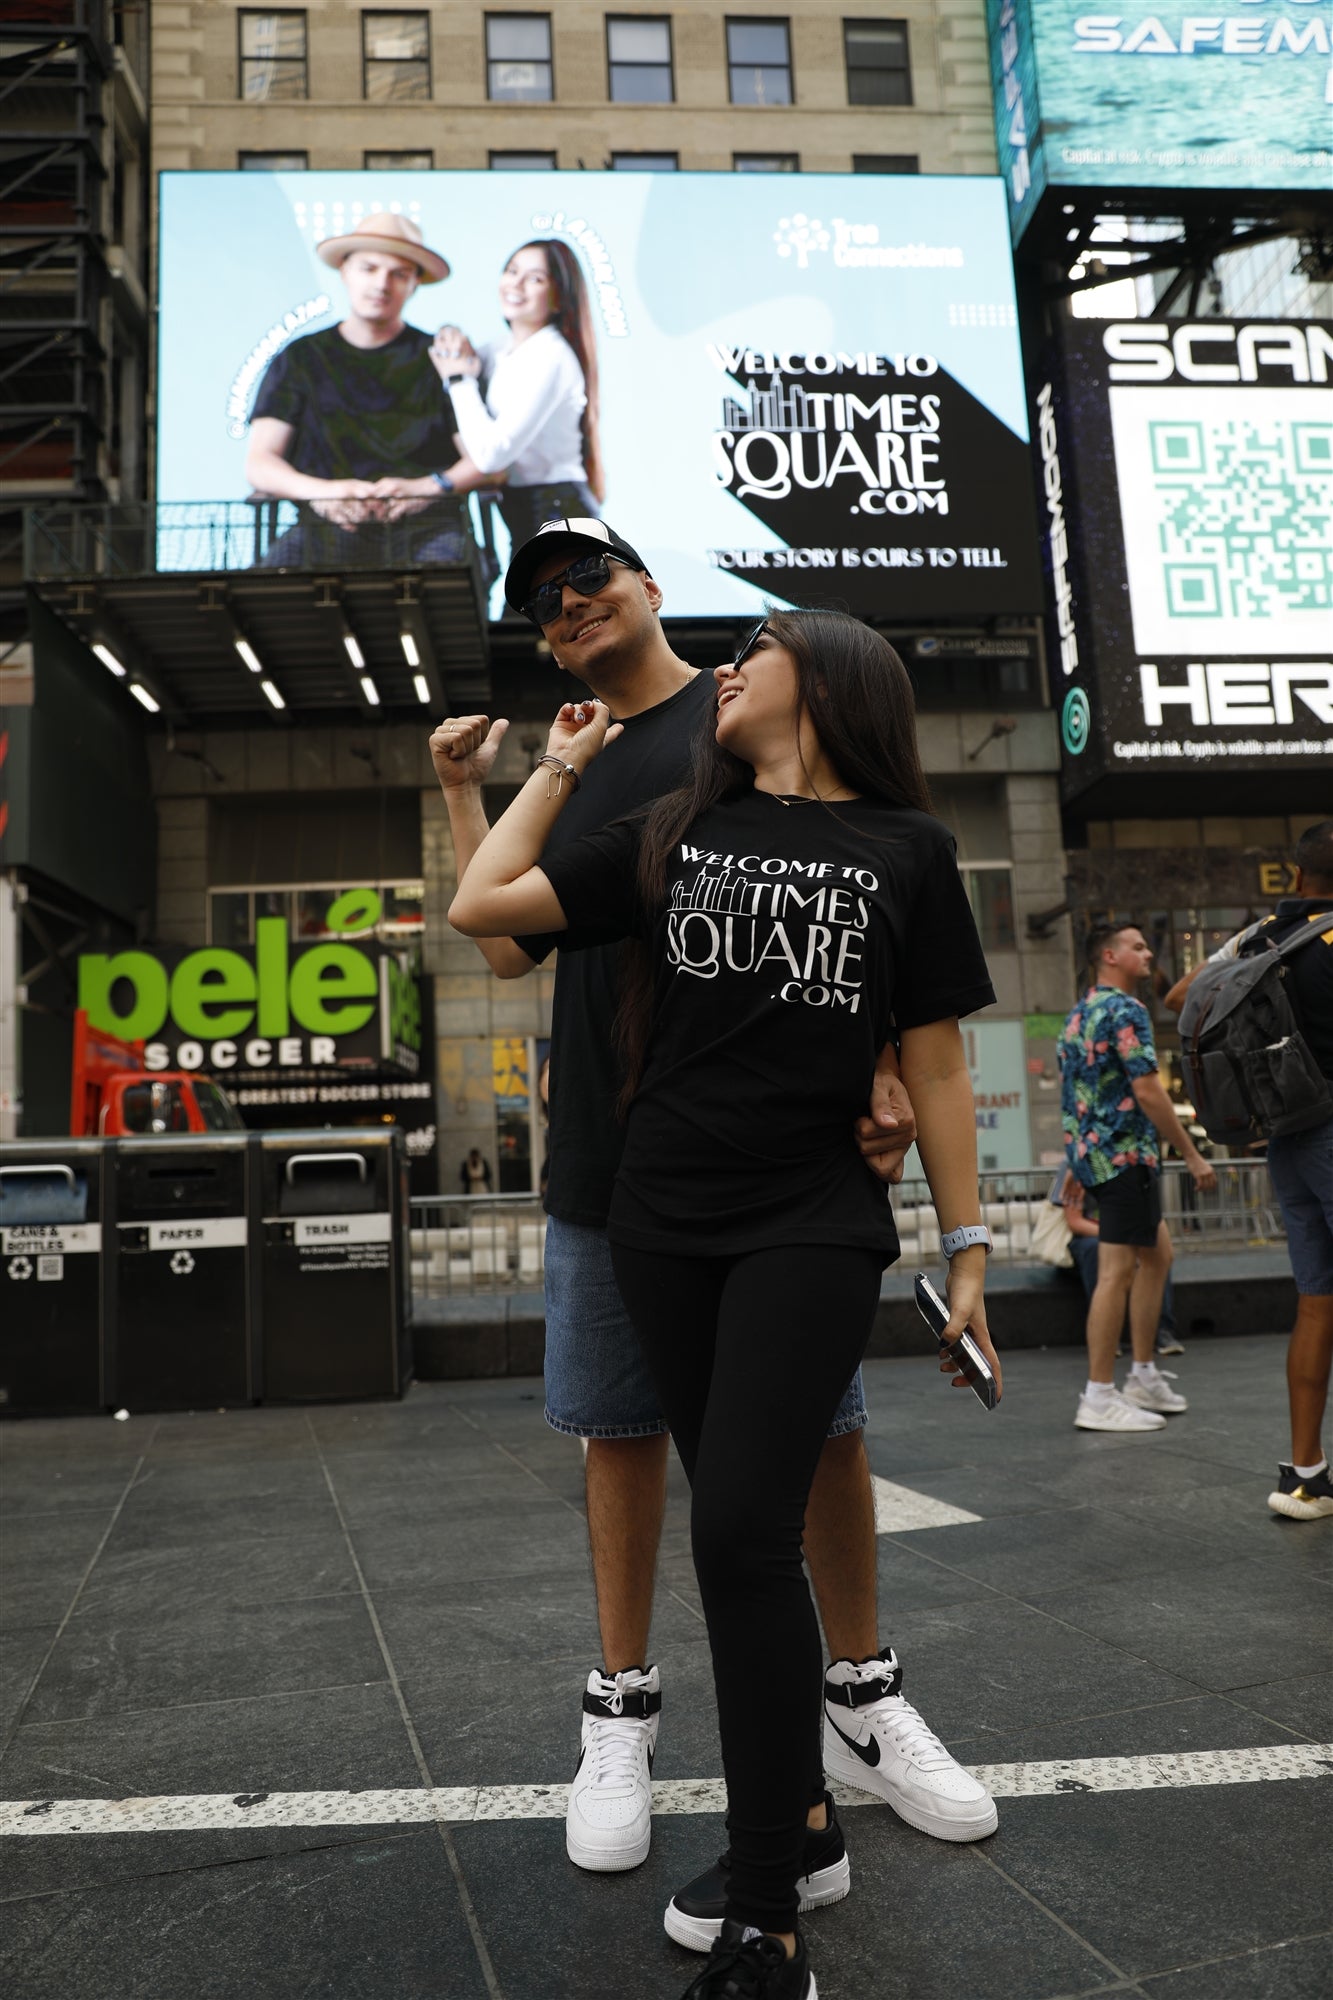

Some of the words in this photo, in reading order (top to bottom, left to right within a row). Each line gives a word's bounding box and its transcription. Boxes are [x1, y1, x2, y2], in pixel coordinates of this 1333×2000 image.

[1072, 16, 1333, 54] SAFEM
[708, 345, 888, 375] WELCOME
[890, 352, 938, 377] TO
[807, 392, 941, 432] TIMES
[711, 430, 946, 499] SQUARE
[850, 489, 949, 515] .COM
[710, 548, 770, 569] YOUR
[772, 547, 838, 568] STORY
[842, 548, 859, 567] IS
[862, 547, 924, 568] OURS
[926, 547, 957, 568] TO
[1113, 741, 1149, 758] Capital
[1150, 741, 1161, 757] at
[1184, 740, 1217, 758] Crypto
[681, 844, 835, 878] WELCOME
[841, 866, 879, 891] TO
[748, 883, 871, 929] TIMES
[667, 912, 865, 988] SQUARE
[770, 981, 860, 1014] .COM
[144, 1037, 337, 1071] SOCCER
[239, 1087, 317, 1105] GREATEST
[319, 1085, 379, 1102] SOCCER
[382, 1083, 431, 1100] STORE
[7, 1239, 65, 1251] BOTTLES
[10, 1226, 46, 1238] CANS
[159, 1229, 204, 1241] PAPER
[305, 1225, 349, 1236] TRASH
